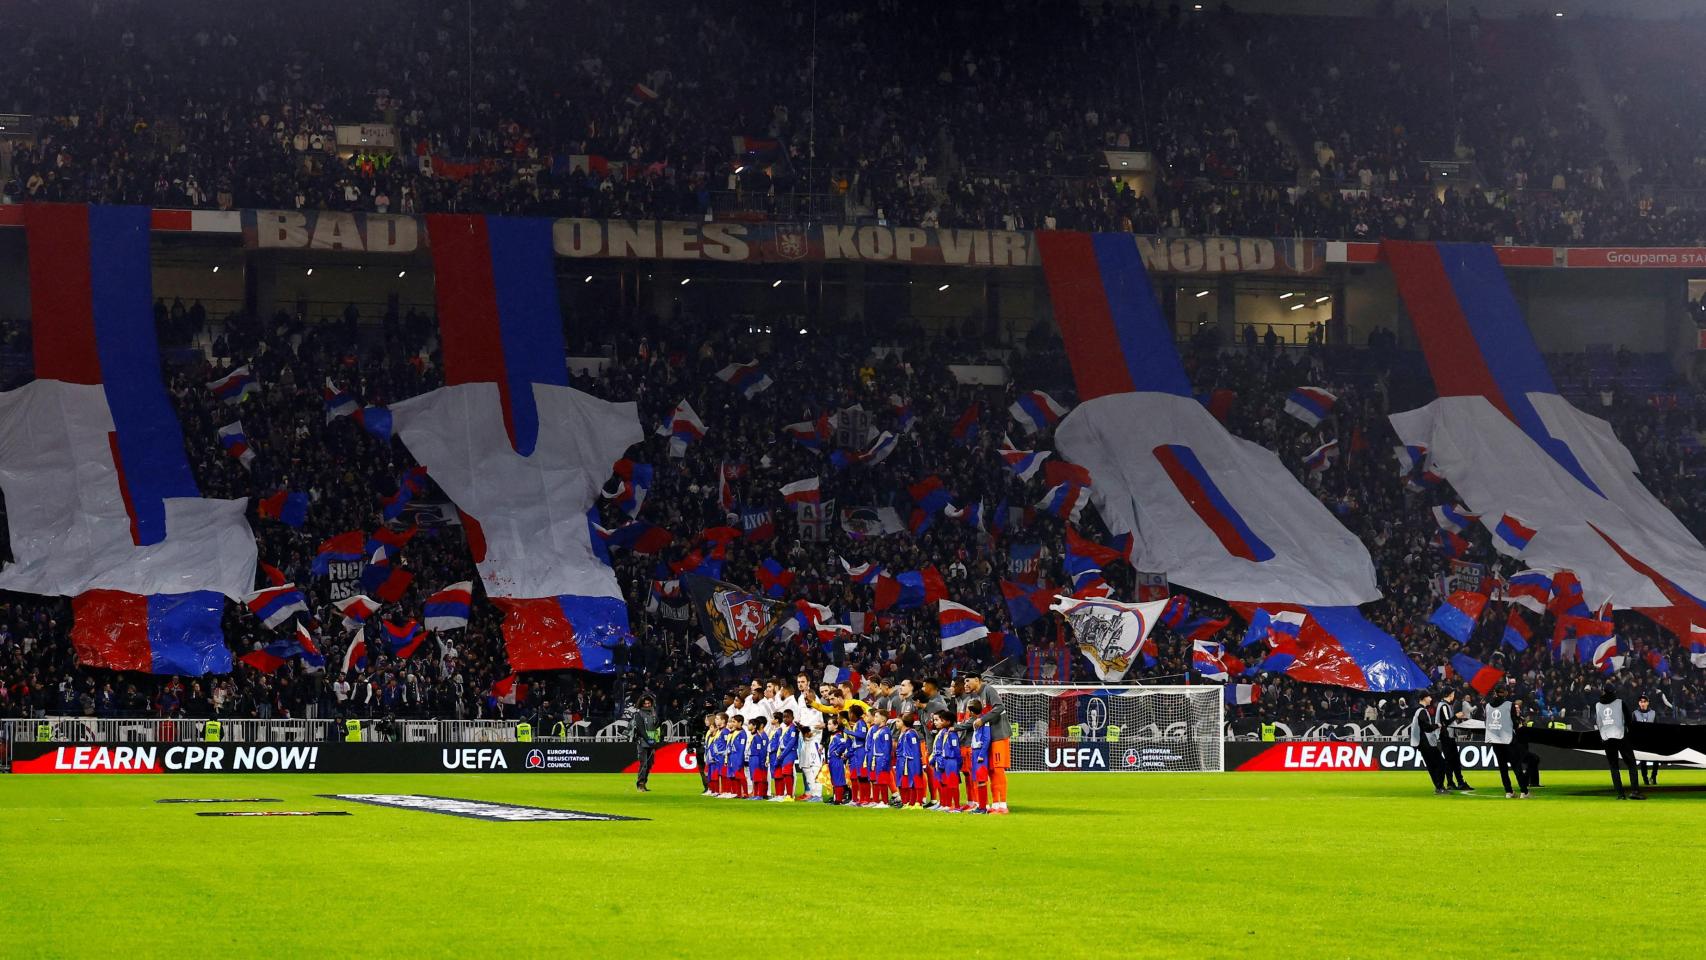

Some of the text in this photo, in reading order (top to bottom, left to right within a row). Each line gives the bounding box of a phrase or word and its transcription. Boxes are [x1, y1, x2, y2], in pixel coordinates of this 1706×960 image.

[257, 209, 1276, 272] BAD ONES KOP VIR NORD
[1606, 251, 1706, 265] Groupama STA
[54, 746, 318, 770] LEARN CPR NOW!
[443, 748, 508, 769] UEFA
[1044, 748, 1106, 768] UEFA
[1284, 745, 1373, 768] LEARN
